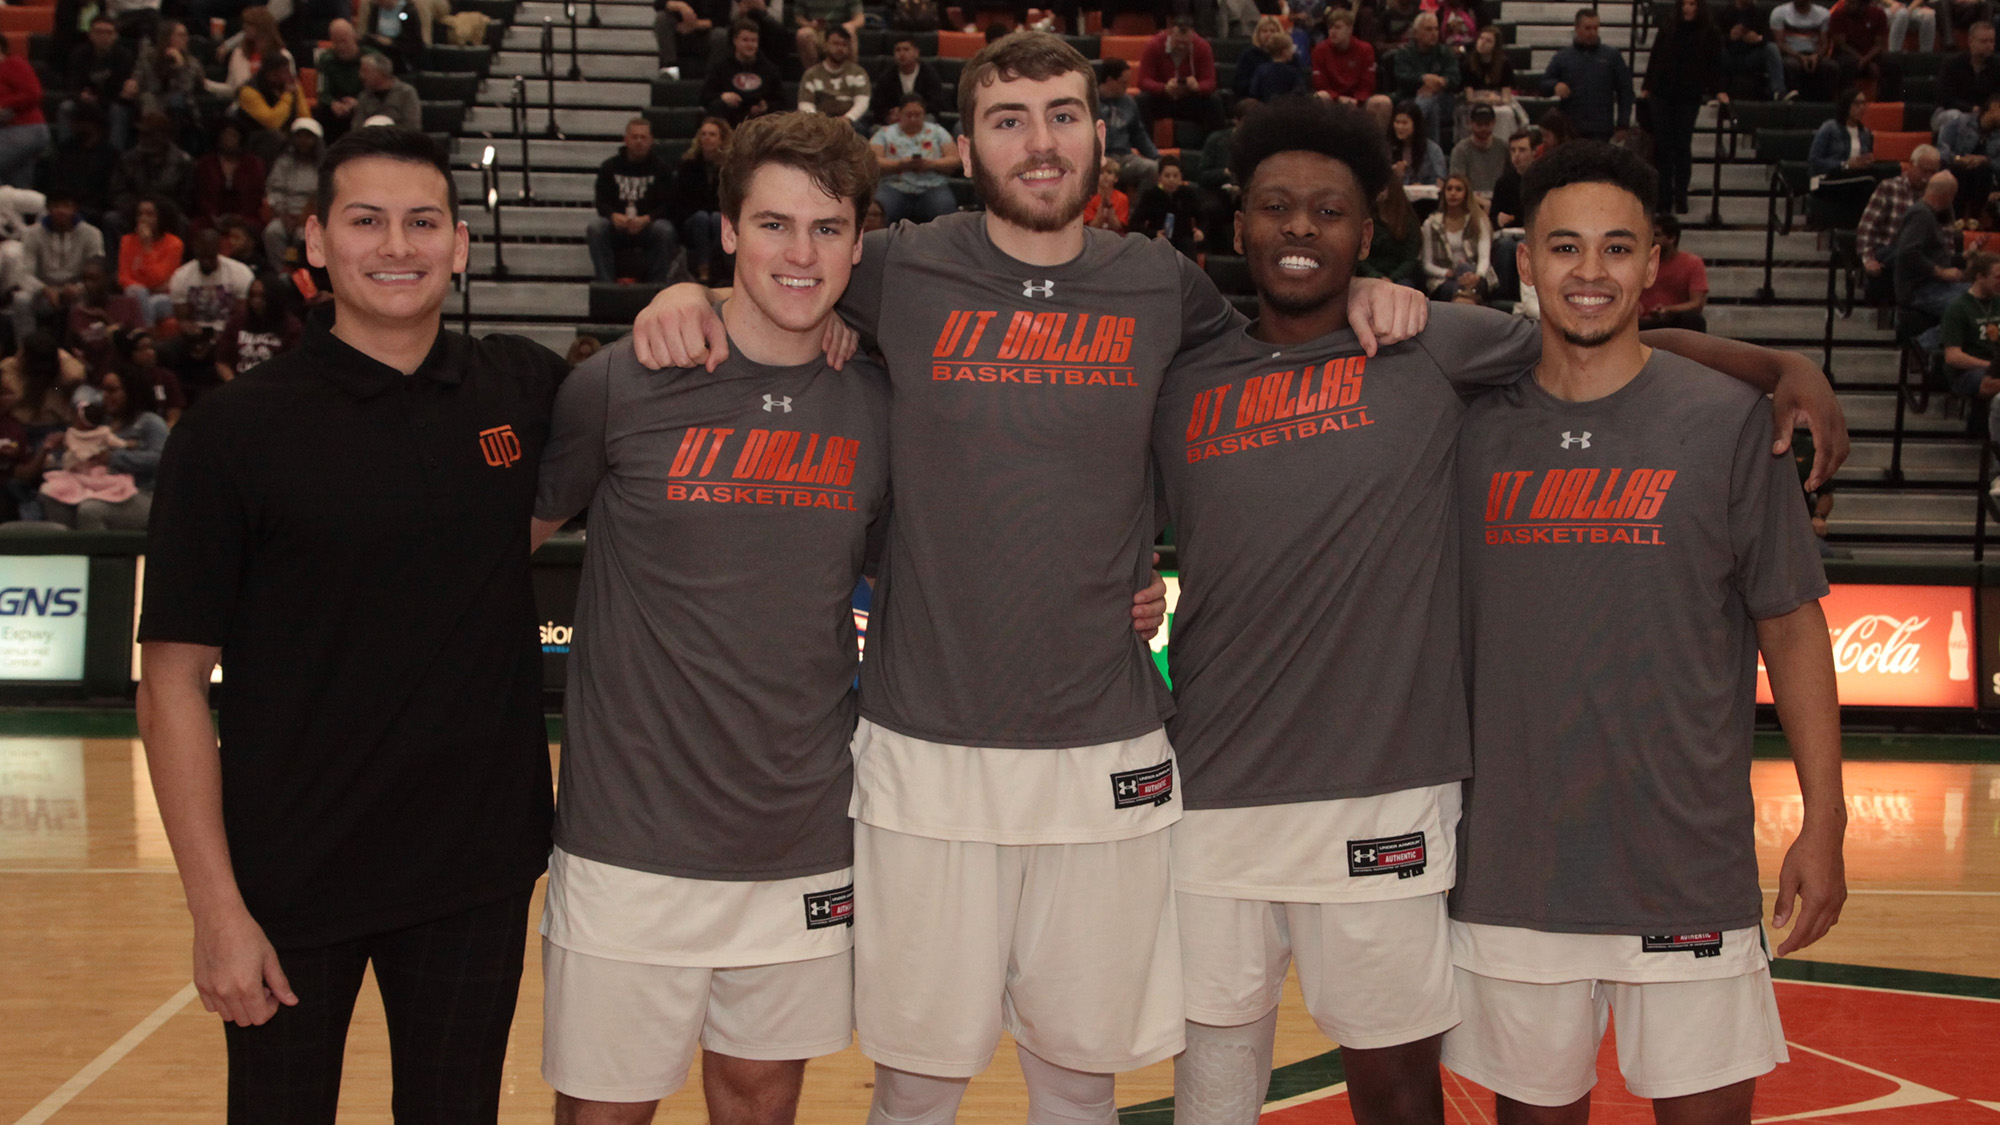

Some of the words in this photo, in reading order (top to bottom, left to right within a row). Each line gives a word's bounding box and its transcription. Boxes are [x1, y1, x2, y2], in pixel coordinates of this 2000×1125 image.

[932, 310, 998, 357] UT
[997, 310, 1137, 364] DALLAS
[932, 365, 1139, 387] BASKETBALL
[1186, 384, 1232, 443] UT
[1235, 355, 1367, 429] DALLAS
[667, 427, 735, 477] UT
[731, 429, 861, 487] DALLAS
[1186, 411, 1375, 464] BASKETBALL
[667, 484, 858, 512] BASKETBALL
[1485, 471, 1534, 522] UT
[1529, 468, 1678, 520] DALLAS
[1485, 527, 1666, 545] BASKETBALL
[1385, 851, 1416, 862] AUTHENTIC
[1398, 840, 1420, 848] ARMOUR
